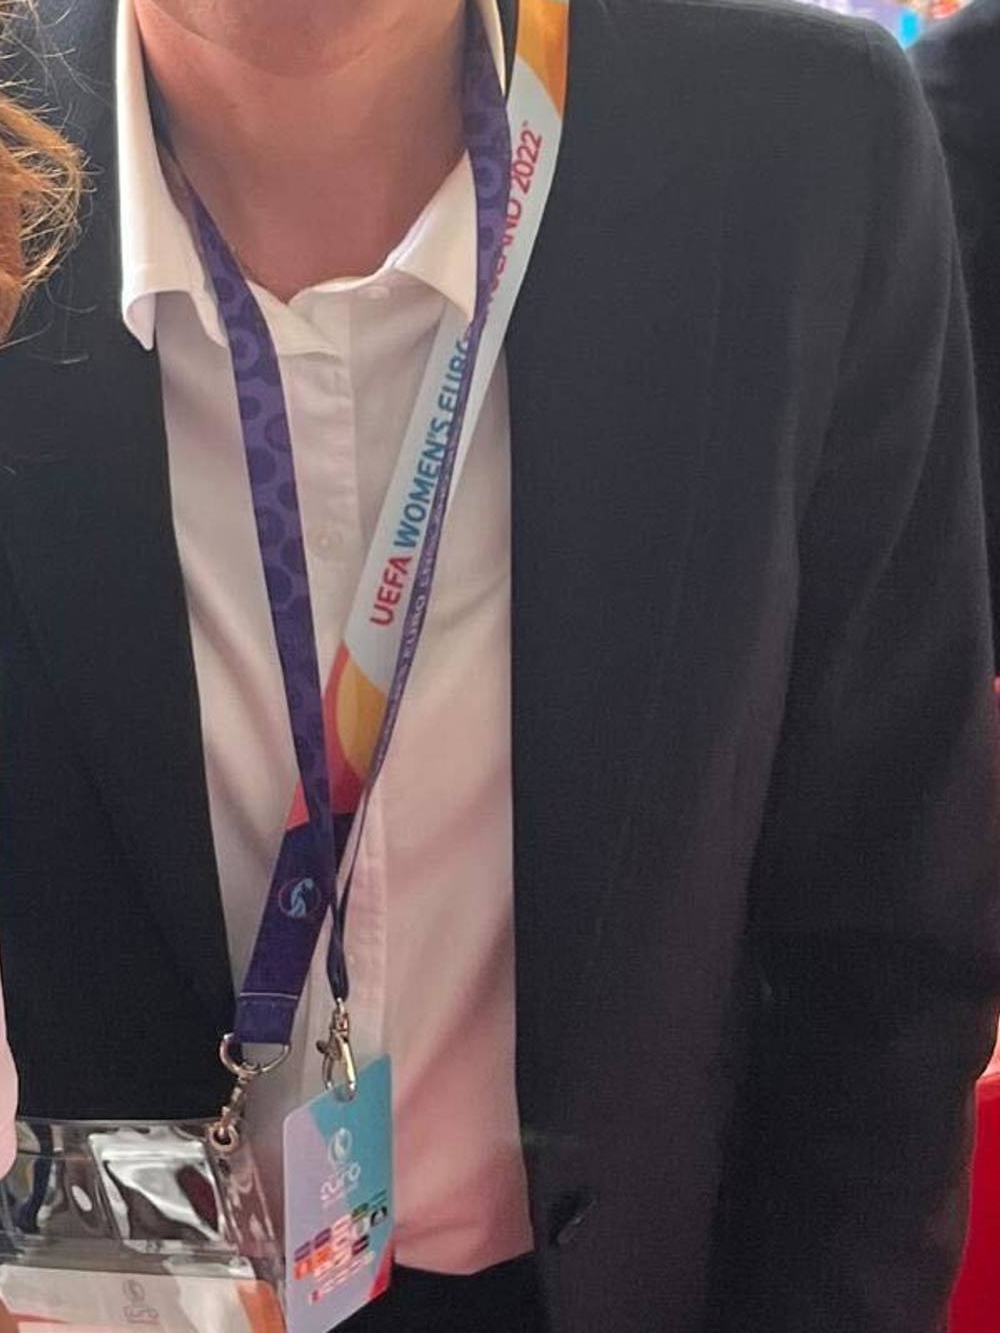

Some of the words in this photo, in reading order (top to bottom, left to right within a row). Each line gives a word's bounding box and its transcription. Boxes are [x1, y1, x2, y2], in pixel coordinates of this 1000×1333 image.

[370, 553, 413, 627] UEFA
[394, 418, 451, 548] WOMEN'S
[511, 128, 542, 194] 2022
